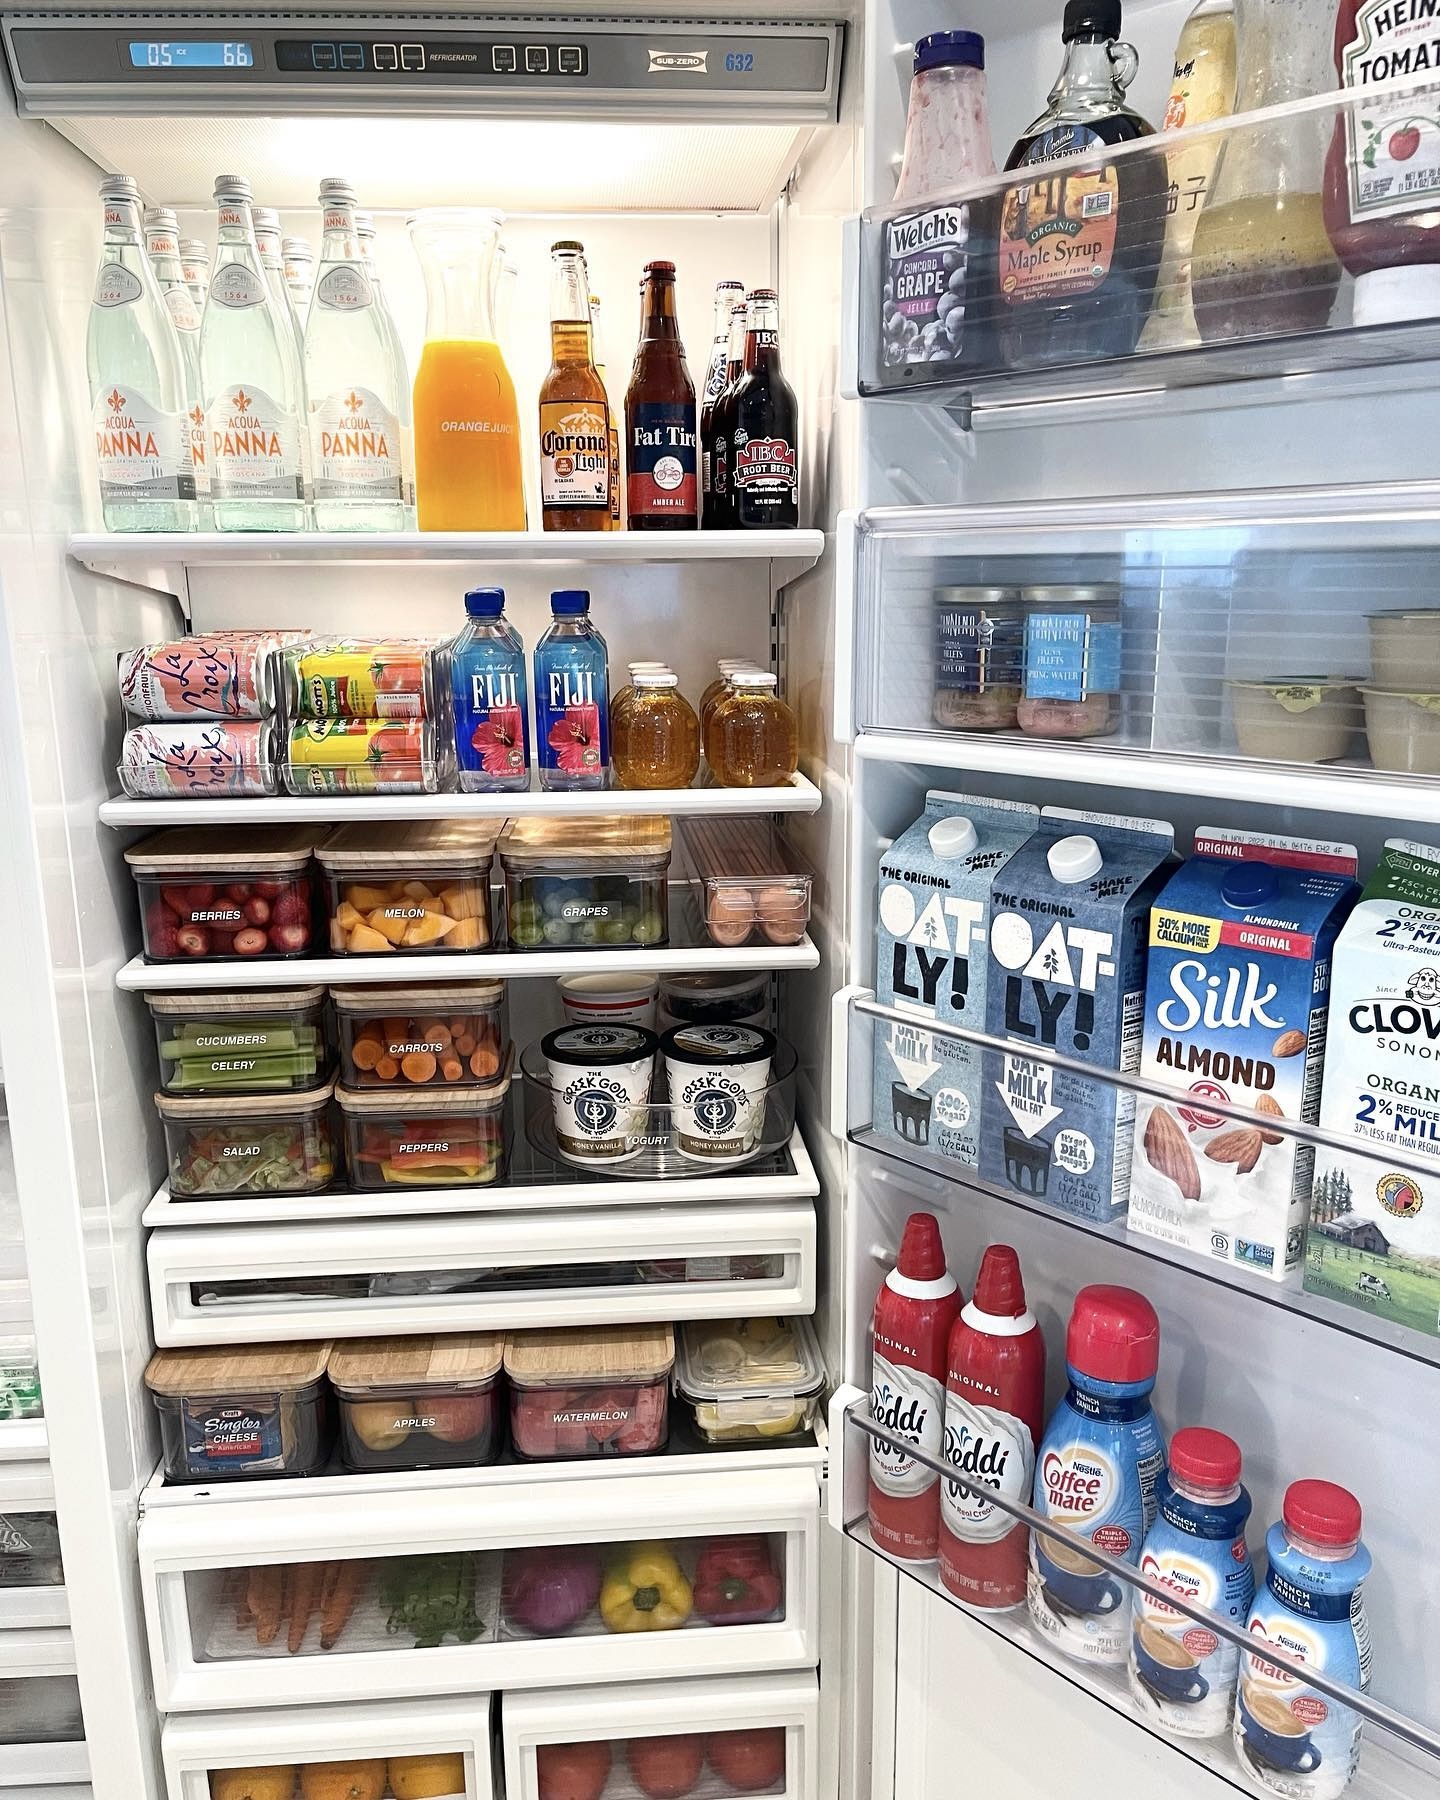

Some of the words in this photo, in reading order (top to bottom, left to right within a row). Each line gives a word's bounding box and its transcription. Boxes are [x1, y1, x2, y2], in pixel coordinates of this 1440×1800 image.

[1374, 0, 1440, 37] HEIN
[429, 54, 478, 62] REFRIGERATOR
[656, 57, 700, 66] SUB-ZERO
[725, 54, 754, 72] 632
[894, 212, 959, 252] Welch's
[1031, 221, 1077, 240] ORGANIC
[1008, 245, 1051, 274] Maple
[1054, 240, 1103, 267] Syrup
[904, 258, 938, 275] CONCORD
[1046, 270, 1068, 278] FAMILY
[897, 271, 945, 300] GRAPE
[100, 291, 121, 299] 1564
[224, 291, 248, 299] 1564
[333, 294, 358, 303] 1564
[906, 301, 931, 314] JELLY
[105, 416, 136, 430] ACQUA
[228, 417, 262, 429] ACQUA
[338, 418, 371, 430] ACQUA
[441, 421, 490, 433] ORANGE
[96, 431, 160, 458] PANNA
[213, 431, 283, 458] PANNA
[321, 431, 389, 459] PANNA
[542, 430, 606, 459] Corona
[634, 427, 663, 447] Fat
[751, 445, 784, 462] IBC
[742, 464, 768, 476] ROOT
[770, 463, 791, 475] BEER
[1051, 670, 1080, 680] WATER
[471, 672, 518, 709] FIJI
[548, 671, 595, 707] FIJI
[1197, 841, 1244, 857] ORIGINAL
[964, 851, 1004, 866] SHAKE
[971, 859, 996, 872] ME!
[880, 865, 902, 881] THE
[903, 869, 952, 889] ORIGINAL
[1412, 862, 1439, 878] OVER
[1089, 875, 1134, 892] SHAKE
[1097, 884, 1126, 898] ME!
[1398, 886, 1429, 901] PLANT
[562, 905, 609, 918] GRAPES
[992, 891, 1017, 909] THE
[1019, 898, 1076, 918] ORIGINAL
[191, 909, 241, 923] BERRIES
[384, 907, 425, 920] MELON
[880, 884, 987, 955] OAT-
[1157, 916, 1181, 933] 50%
[1181, 921, 1211, 938] MORE
[1243, 914, 1300, 931] ALMONDMILK
[1375, 918, 1416, 938] 2%
[1156, 928, 1196, 947] CALCIUM
[1239, 931, 1291, 952] ORIGINAL
[990, 911, 1116, 992] OAT-
[892, 942, 969, 1011] LY!
[1156, 959, 1287, 1033] Silk
[1375, 985, 1398, 993] Since
[1005, 975, 1095, 1051] LY!
[196, 1035, 267, 1047] CUCUMBERS
[389, 1042, 444, 1055] CARROTS
[933, 1045, 942, 1053] No
[895, 1035, 929, 1066] MILK
[210, 1060, 256, 1073] CELERY
[1156, 1036, 1276, 1091] ALMOND
[1007, 1070, 1048, 1105] MILK
[938, 1091, 969, 1114] 100%
[1011, 1097, 1029, 1112] FULL
[1029, 1103, 1044, 1117] FAT
[1355, 1094, 1393, 1125] 2%
[574, 1120, 593, 1136] GREEK
[593, 1121, 619, 1137] YOGURT
[693, 1119, 712, 1136] GREEK
[712, 1121, 738, 1136] YOGURT
[1354, 1122, 1369, 1136] 37%
[1369, 1126, 1386, 1141] LESS
[1386, 1131, 1398, 1143] FAT
[1399, 1135, 1417, 1149] THAN
[398, 1141, 449, 1154] PEPPERS
[572, 1141, 594, 1149] HONEY
[594, 1142, 623, 1150] VANILLA
[625, 1135, 670, 1145] YOGURT
[690, 1141, 712, 1149] HONEY
[712, 1141, 741, 1150] VANILLA
[1061, 1133, 1074, 1143] It's
[1074, 1137, 1088, 1149] got
[222, 1145, 261, 1157] SALAD
[1060, 1143, 1088, 1160] DHA
[1058, 1180, 1078, 1196] (1/2
[1131, 1194, 1183, 1228] ALMONDMILK
[1255, 1250, 1273, 1259] GMO
[949, 1369, 1001, 1397] ORIGINAL
[1075, 1397, 1100, 1415] VANILLA
[1076, 1390, 1100, 1407] FRENCH
[204, 1416, 260, 1434] Singles
[393, 1416, 436, 1430] APPLES
[552, 1410, 628, 1424] WATERMELON
[213, 1432, 258, 1444] CHEESE
[880, 1461, 894, 1472] Real
[894, 1459, 917, 1473] Cream
[1043, 1452, 1102, 1495] Coffee
[1048, 1489, 1098, 1512] mate
[956, 1505, 973, 1518] Real
[1163, 1506, 1198, 1529] FRENCH
[1164, 1513, 1198, 1534] VANILLA
[1096, 1534, 1127, 1542] CHURNED
[1101, 1529, 1123, 1537] TRIPLE
[1273, 1580, 1311, 1609] VANILLA
[1274, 1573, 1311, 1600] FRENCH
